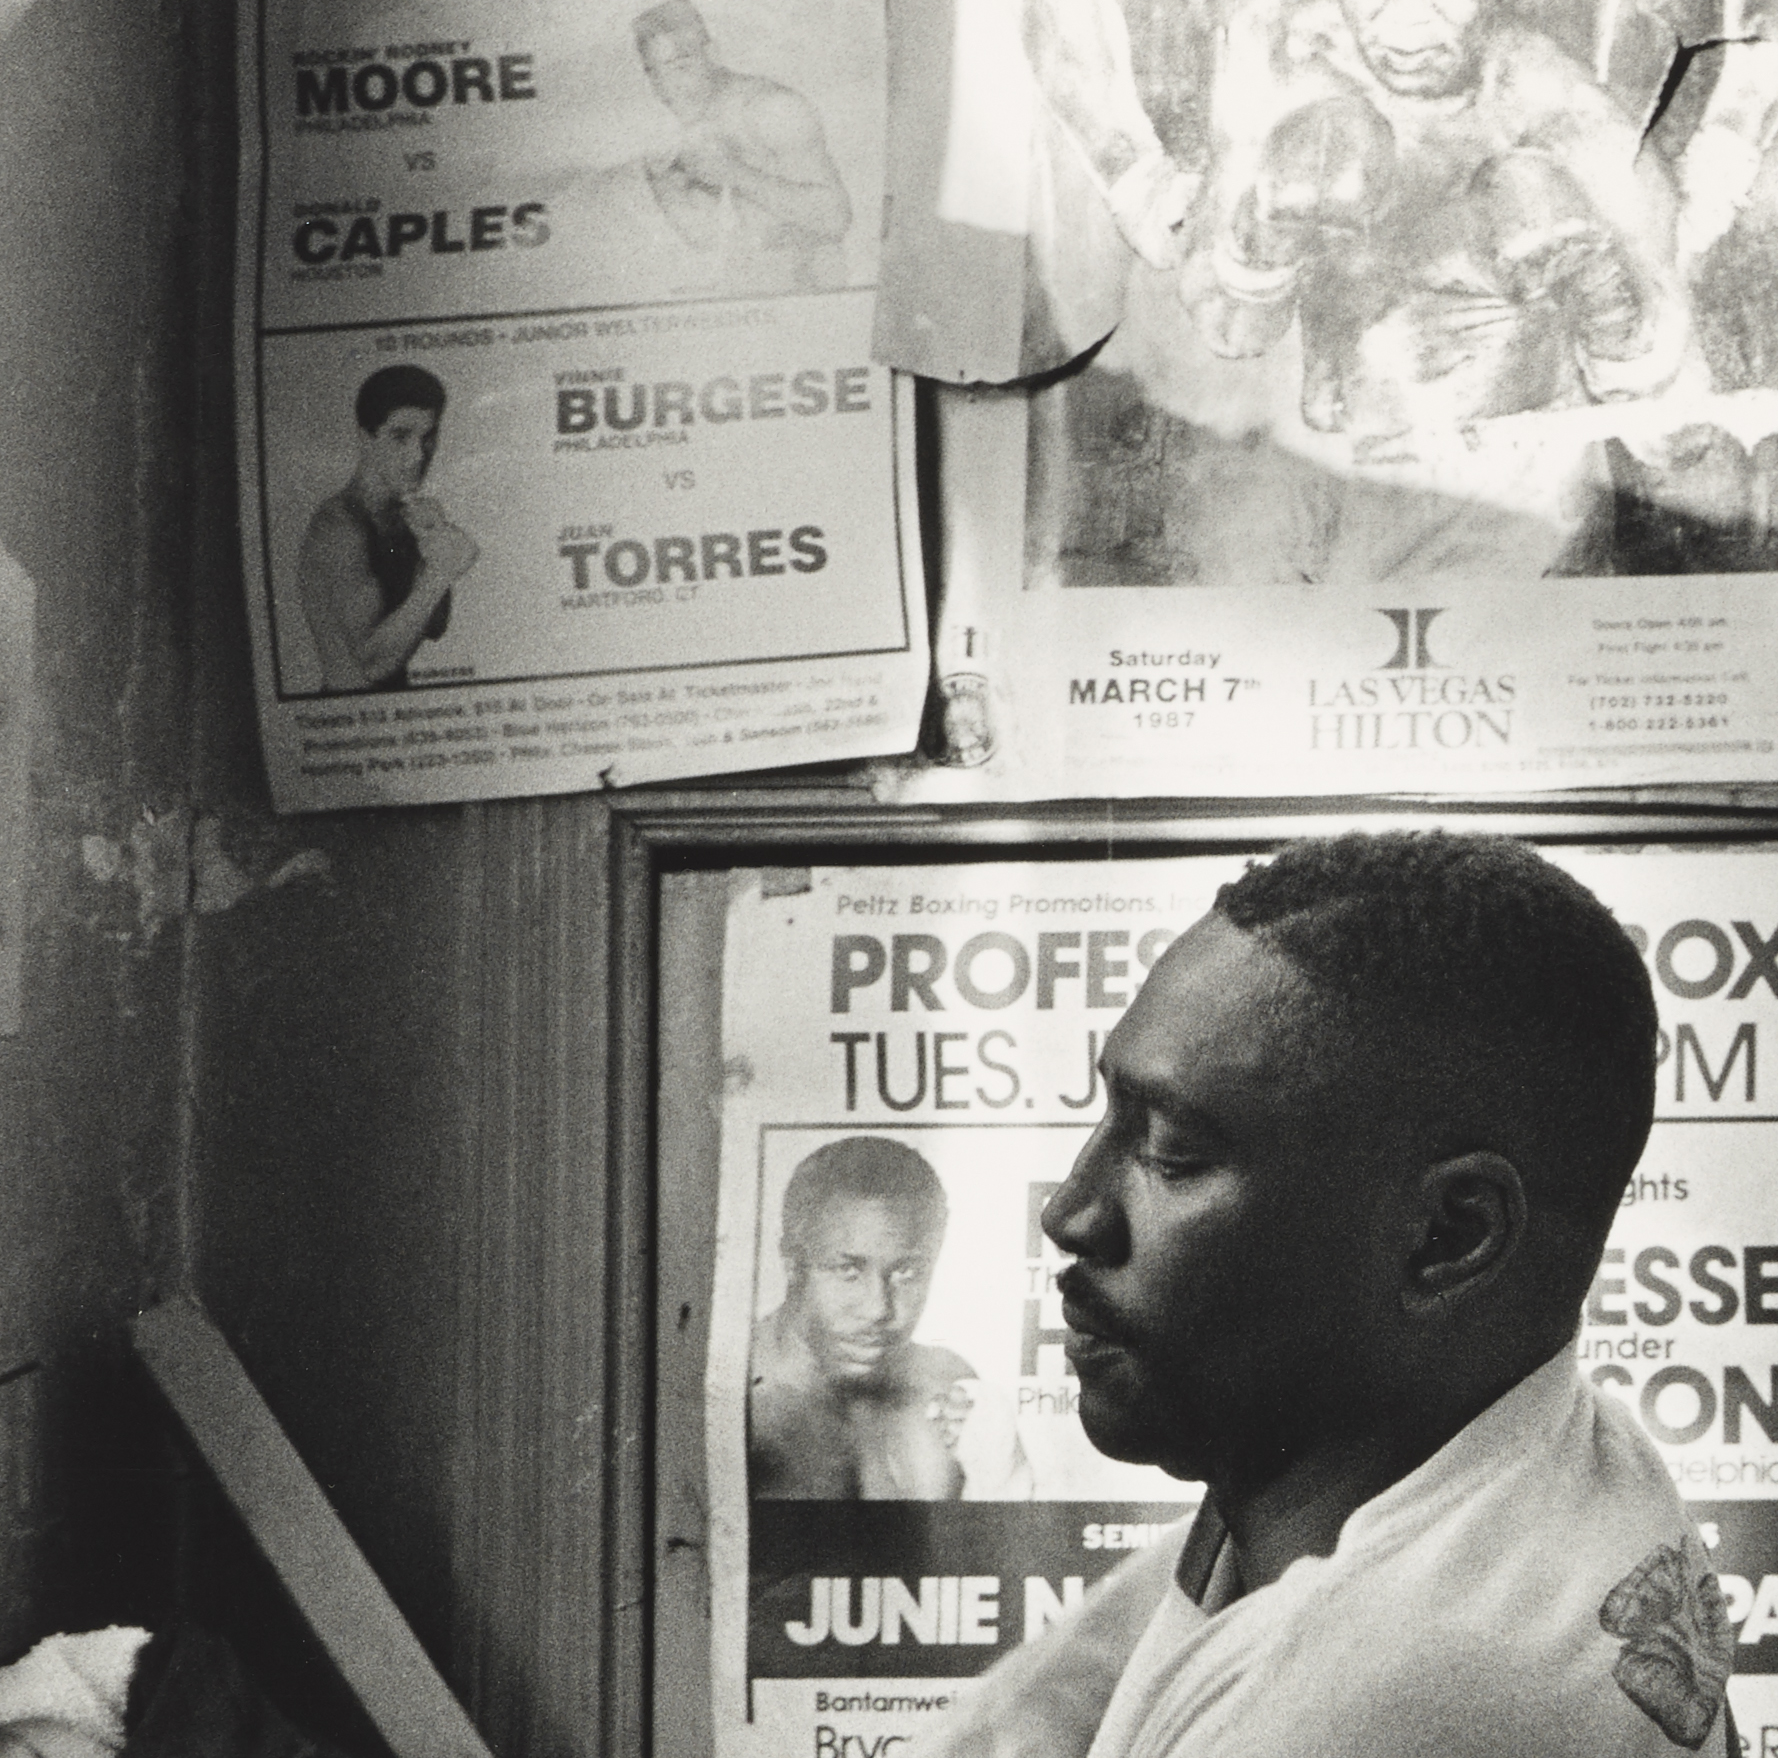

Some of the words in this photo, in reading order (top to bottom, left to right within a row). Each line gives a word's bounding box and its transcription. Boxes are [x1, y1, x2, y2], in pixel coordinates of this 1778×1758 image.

[296, 54, 537, 117] MOORE
[403, 151, 437, 172] VS
[294, 202, 552, 266] CAPLES
[402, 328, 493, 350] ROUNDS
[511, 321, 588, 344] JUNIOR
[556, 366, 871, 436] BURGESE
[663, 469, 696, 491] VS
[557, 524, 829, 593] TORRES
[1107, 647, 1222, 671] Saturday
[1068, 676, 1206, 707] MARCH
[1307, 676, 1379, 709] LAS
[1387, 673, 1517, 707] VEGAS
[1133, 711, 1196, 731] 1987
[1308, 707, 1515, 752] HILTON
[836, 892, 900, 919] Peltz
[909, 892, 1000, 922] Boxing
[830, 1031, 1036, 1113] TUES.
[784, 1574, 1001, 1646] JUNIE
